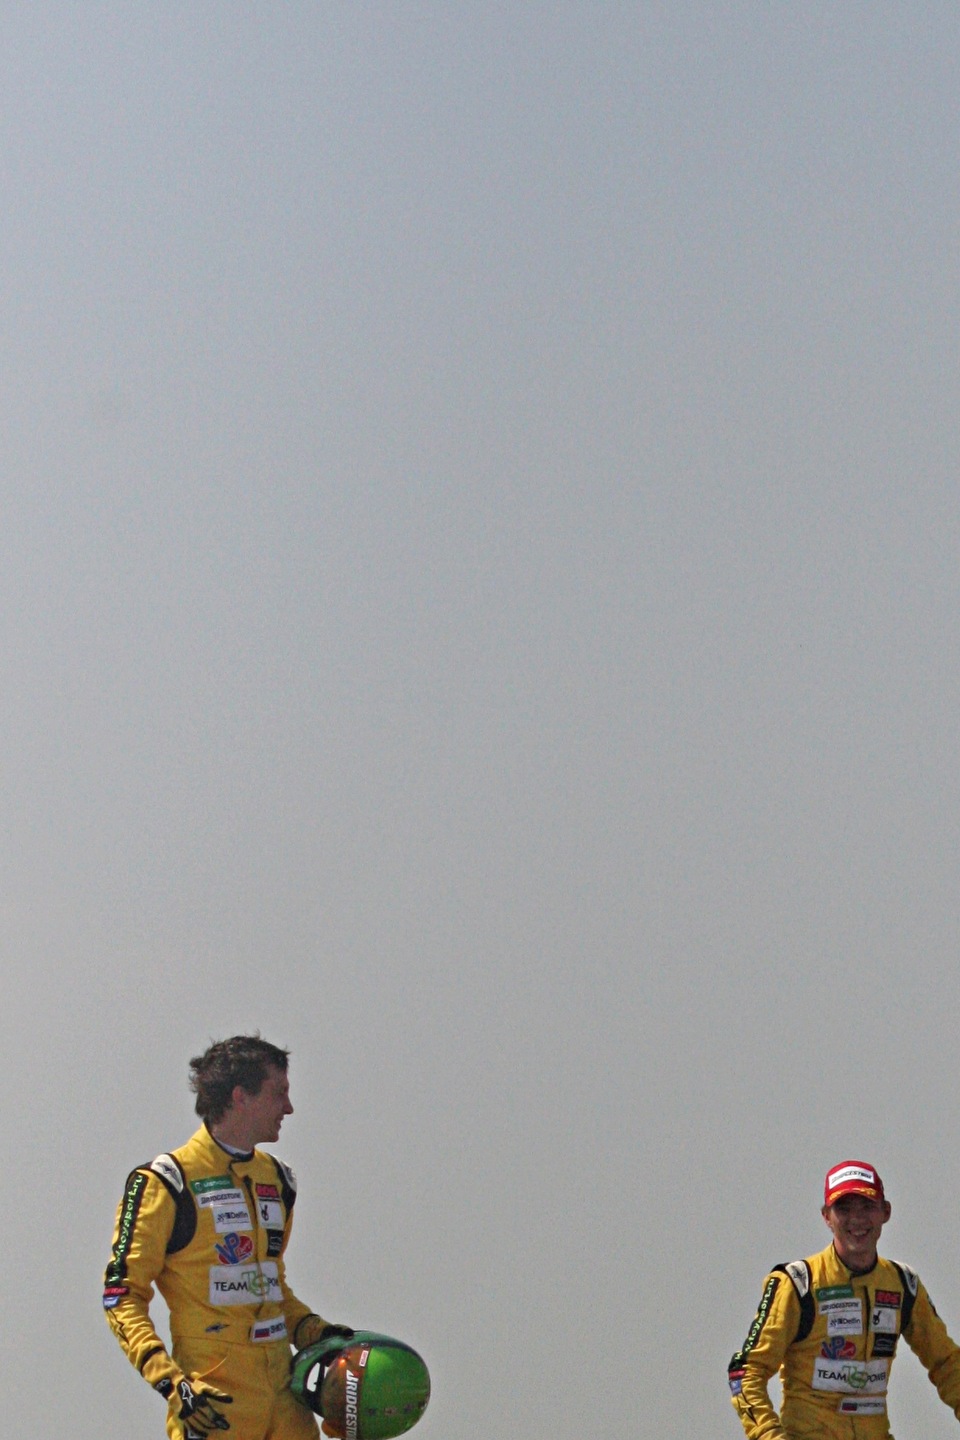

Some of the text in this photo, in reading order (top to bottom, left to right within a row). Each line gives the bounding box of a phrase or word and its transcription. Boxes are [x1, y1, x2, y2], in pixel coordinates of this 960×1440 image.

[201, 1192, 241, 1204] BRIDGESTONE
[213, 1280, 248, 1293] TEAM
[817, 1368, 847, 1381] TEAM
